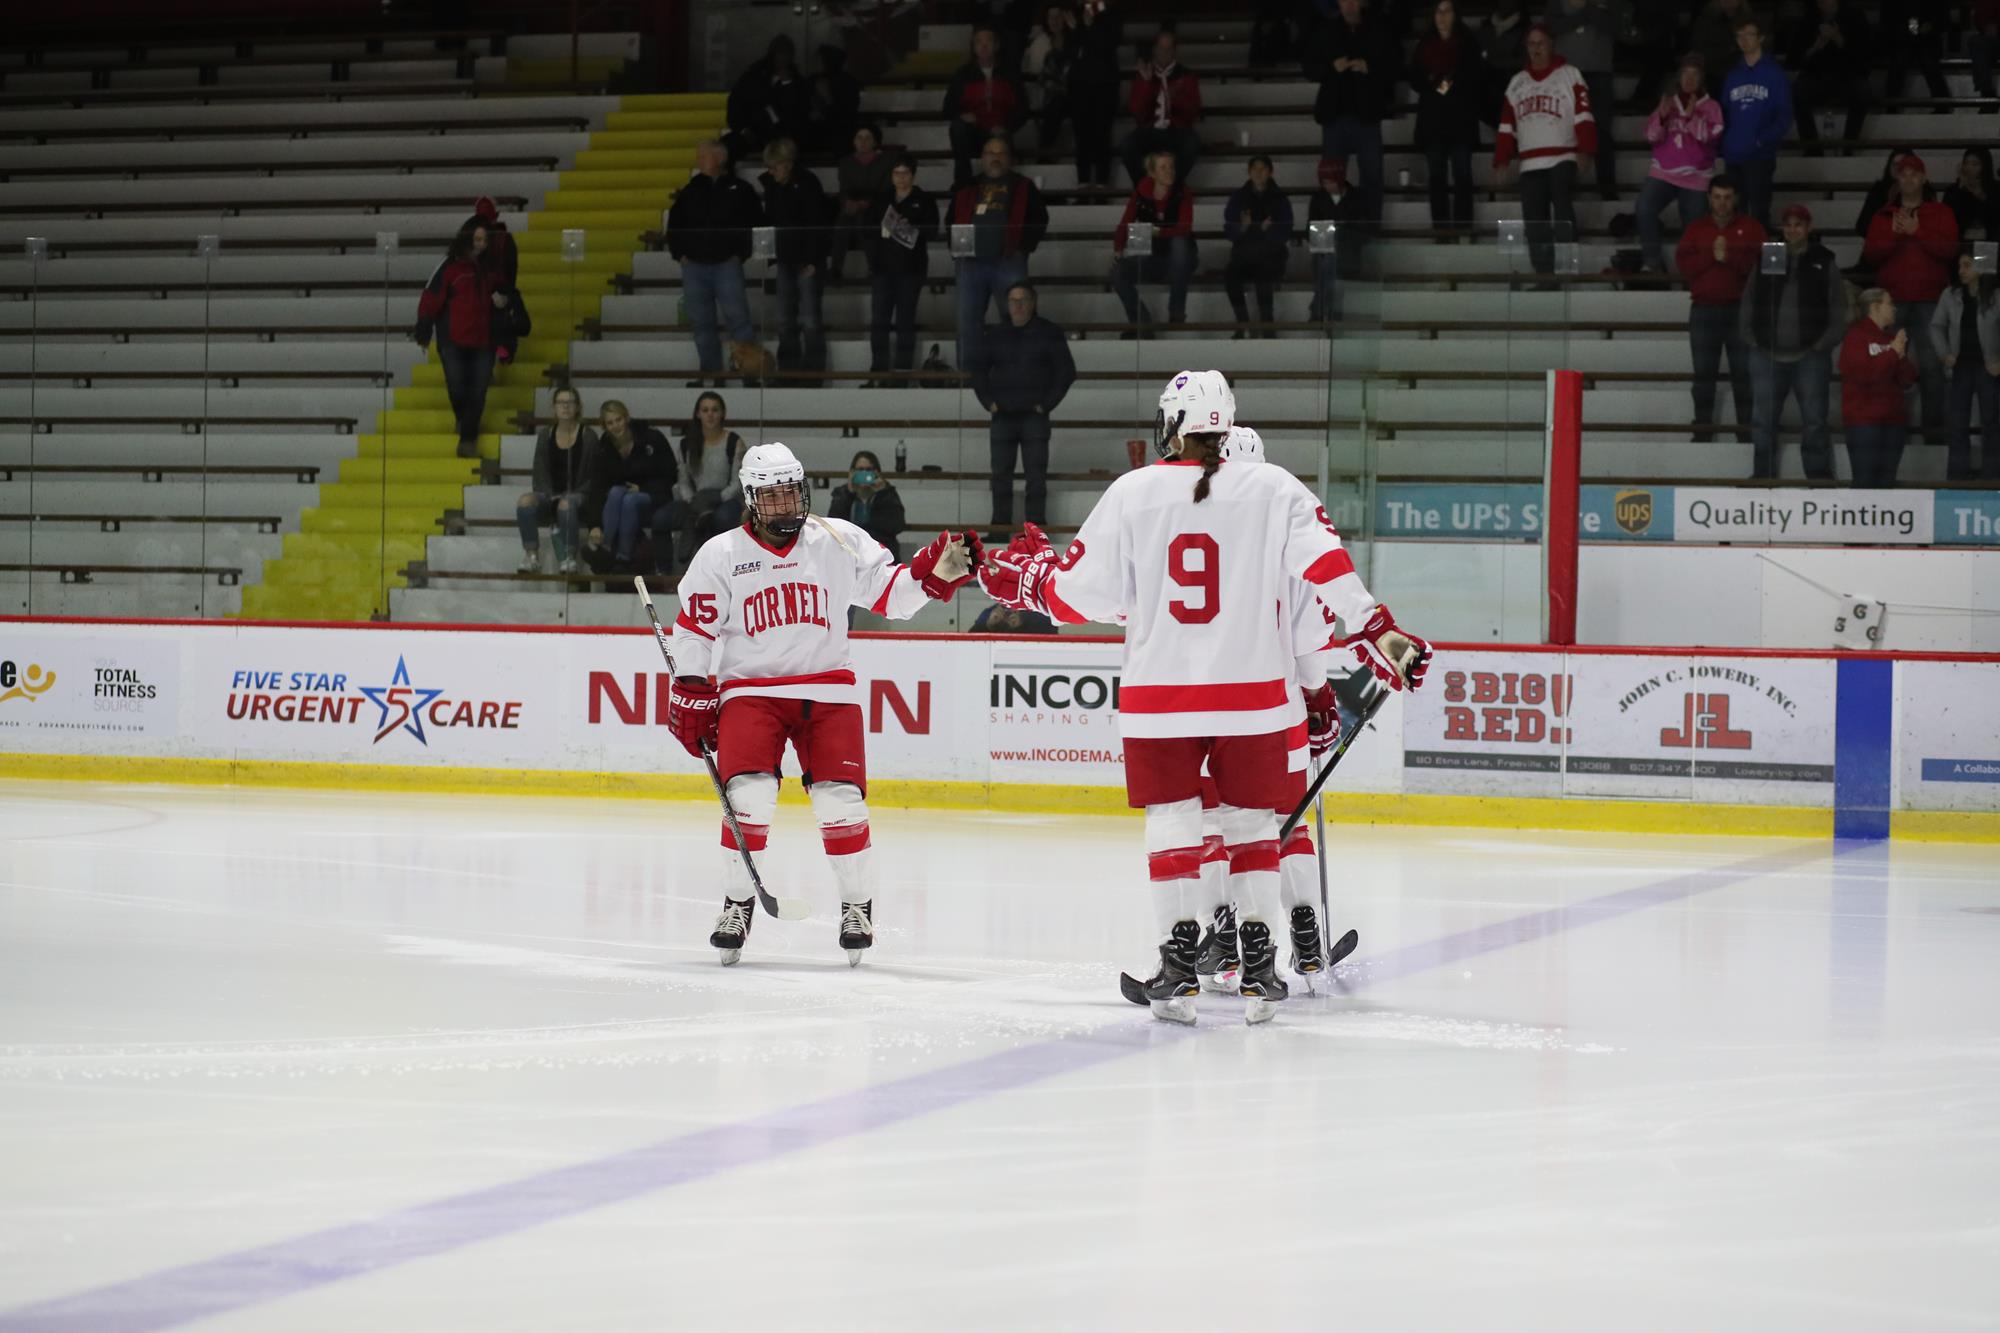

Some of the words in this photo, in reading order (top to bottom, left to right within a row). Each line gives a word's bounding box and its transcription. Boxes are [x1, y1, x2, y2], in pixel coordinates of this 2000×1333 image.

[1209, 411, 1220, 425] 9
[1387, 502, 1441, 530] The
[1452, 503, 1511, 531] UPS
[1617, 502, 1650, 528] ups
[1689, 500, 1792, 533] Quality
[1802, 501, 1914, 534] Printing
[734, 561, 761, 572] ECAC
[1168, 532, 1220, 624] 9
[688, 592, 719, 625] 15
[94, 668, 141, 684] TOTAL
[232, 671, 283, 689] FIVE
[289, 672, 347, 692] STAR
[94, 684, 156, 699] FITNESS
[1471, 672, 1546, 704] BIG
[1618, 676, 1661, 713] JOHN
[1666, 669, 1683, 684] C.
[1688, 665, 1760, 692] LOWERY,
[1765, 685, 1797, 718] INC.
[94, 700, 144, 712] SOURCE
[226, 694, 365, 724] URGENT
[373, 688, 412, 744] 5
[429, 700, 522, 728] CARE
[990, 712, 1089, 725] SHAPING
[990, 748, 1125, 763] www.INCODEMA.c
[1953, 763, 1962, 773] A
